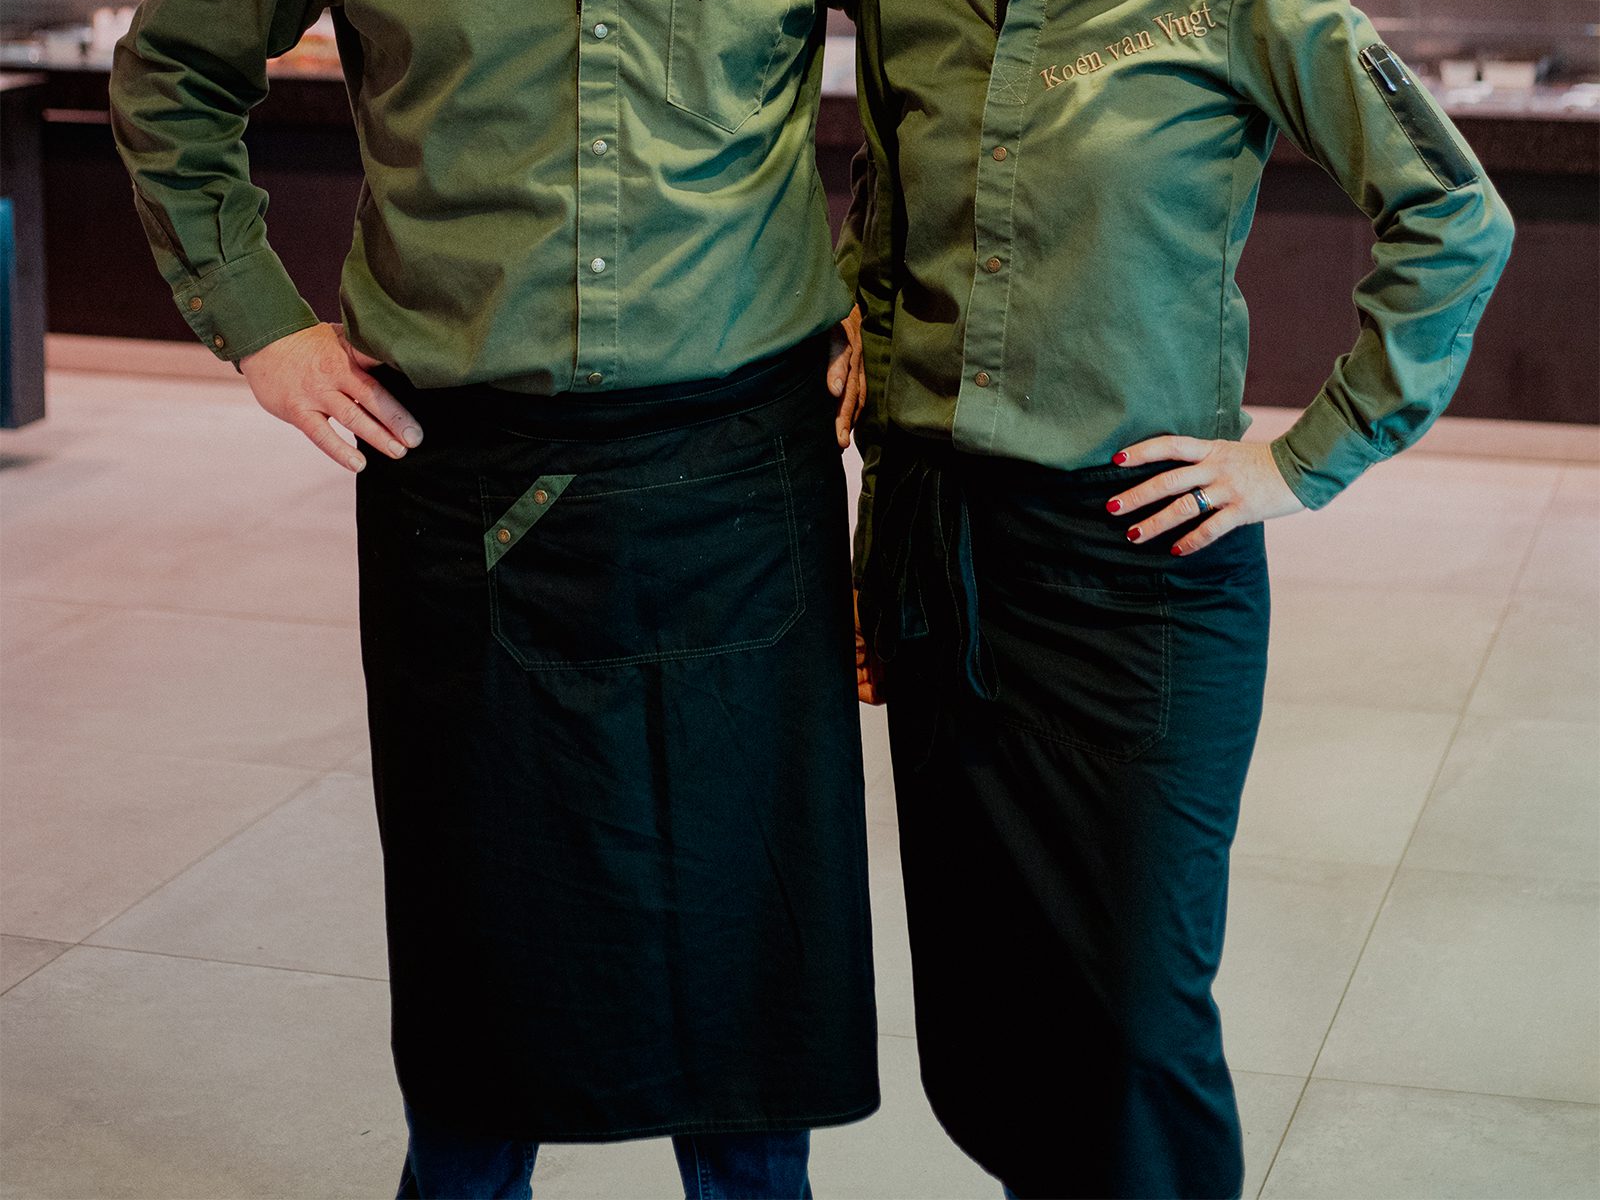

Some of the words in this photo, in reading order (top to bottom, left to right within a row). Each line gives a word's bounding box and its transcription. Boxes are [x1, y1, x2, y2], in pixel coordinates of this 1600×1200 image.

[1039, 50, 1107, 91] Koen
[1105, 29, 1155, 61] van
[1152, 2, 1217, 41] Vugt
